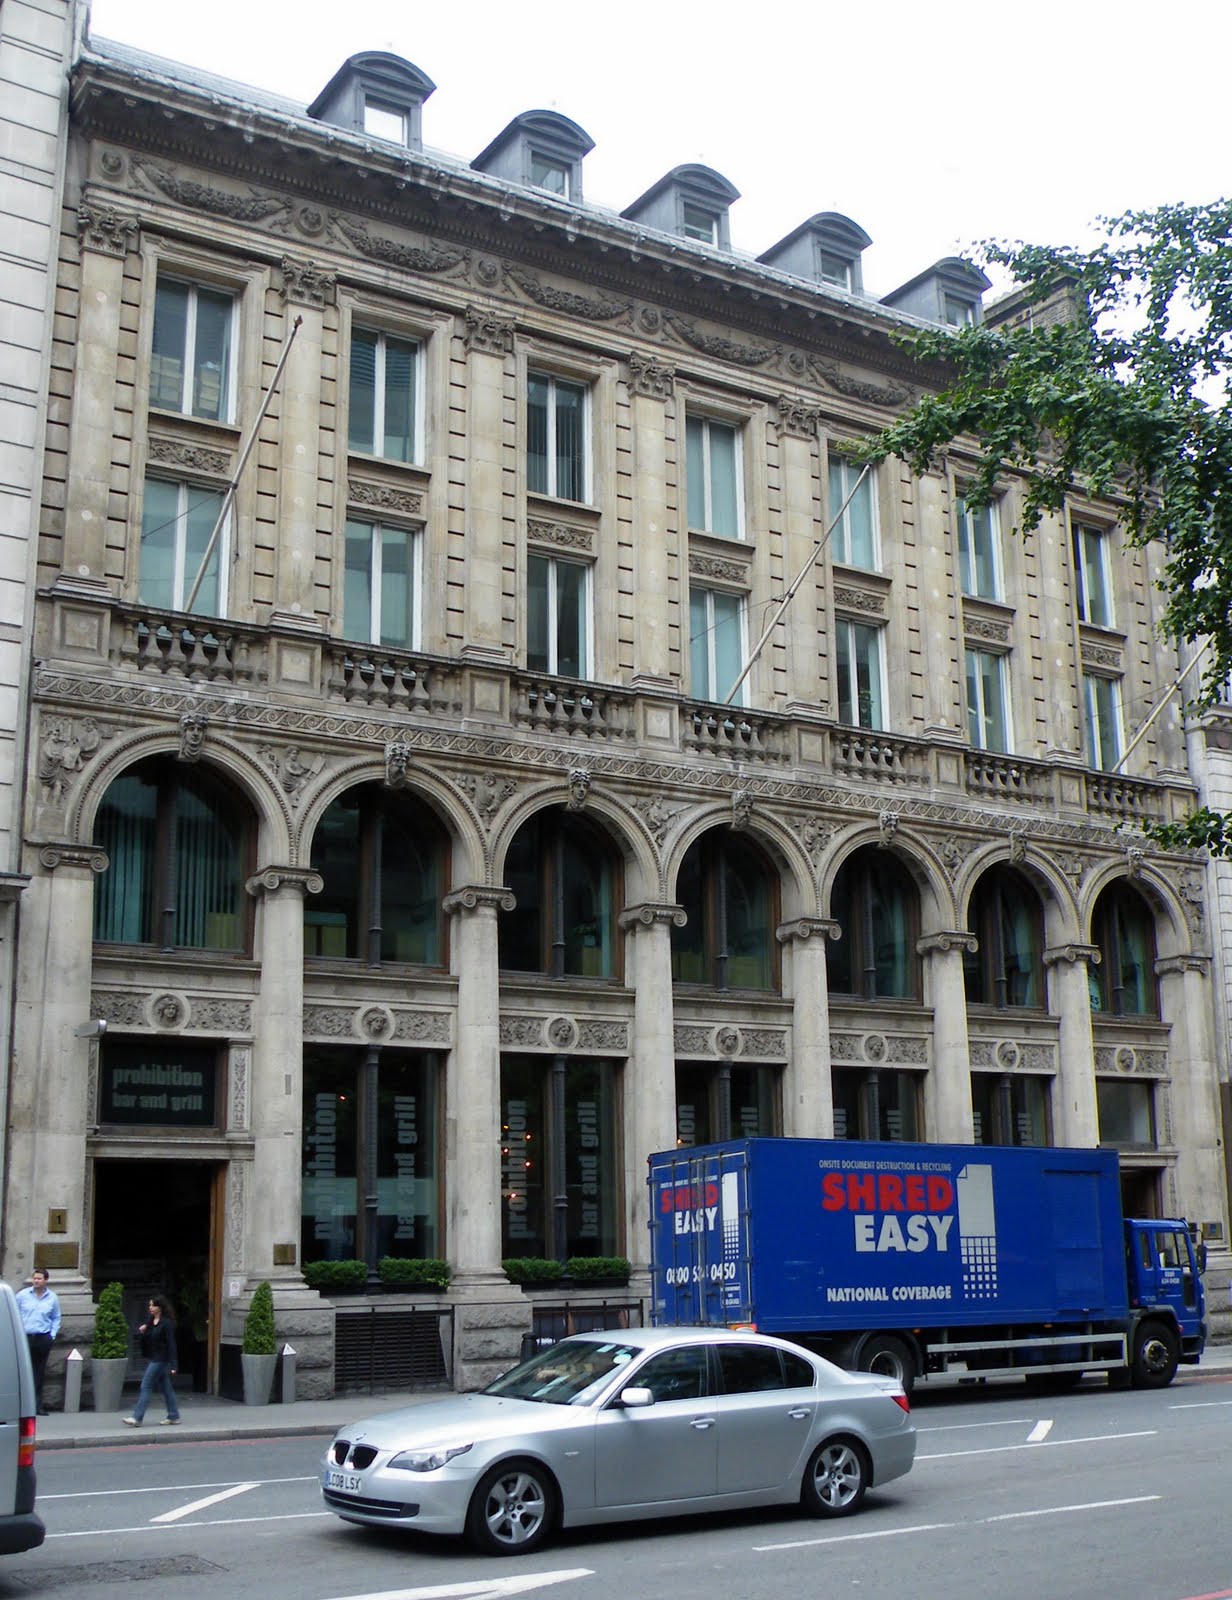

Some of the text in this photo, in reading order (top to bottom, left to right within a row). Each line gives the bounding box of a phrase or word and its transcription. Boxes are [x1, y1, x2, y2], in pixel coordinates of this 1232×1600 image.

[112, 1064, 203, 1090] prohibition
[112, 1092, 202, 1111] bar and grill
[394, 1095, 418, 1145] grill
[577, 1101, 599, 1238] bar and grill
[818, 1159, 841, 1169] ONSITE
[841, 1160, 875, 1170] DOCUMENT
[876, 1161, 915, 1171] DESTRUCTION
[922, 1162, 952, 1172] RECYCLING
[821, 1172, 954, 1212] SHRED
[56, 1214, 62, 1225] 1
[854, 1214, 954, 1253] EASY
[710, 1261, 736, 1281] 0450
[826, 1285, 952, 1303] NATIONAL COVERAGE
[345, 1476, 362, 1491] LSX
